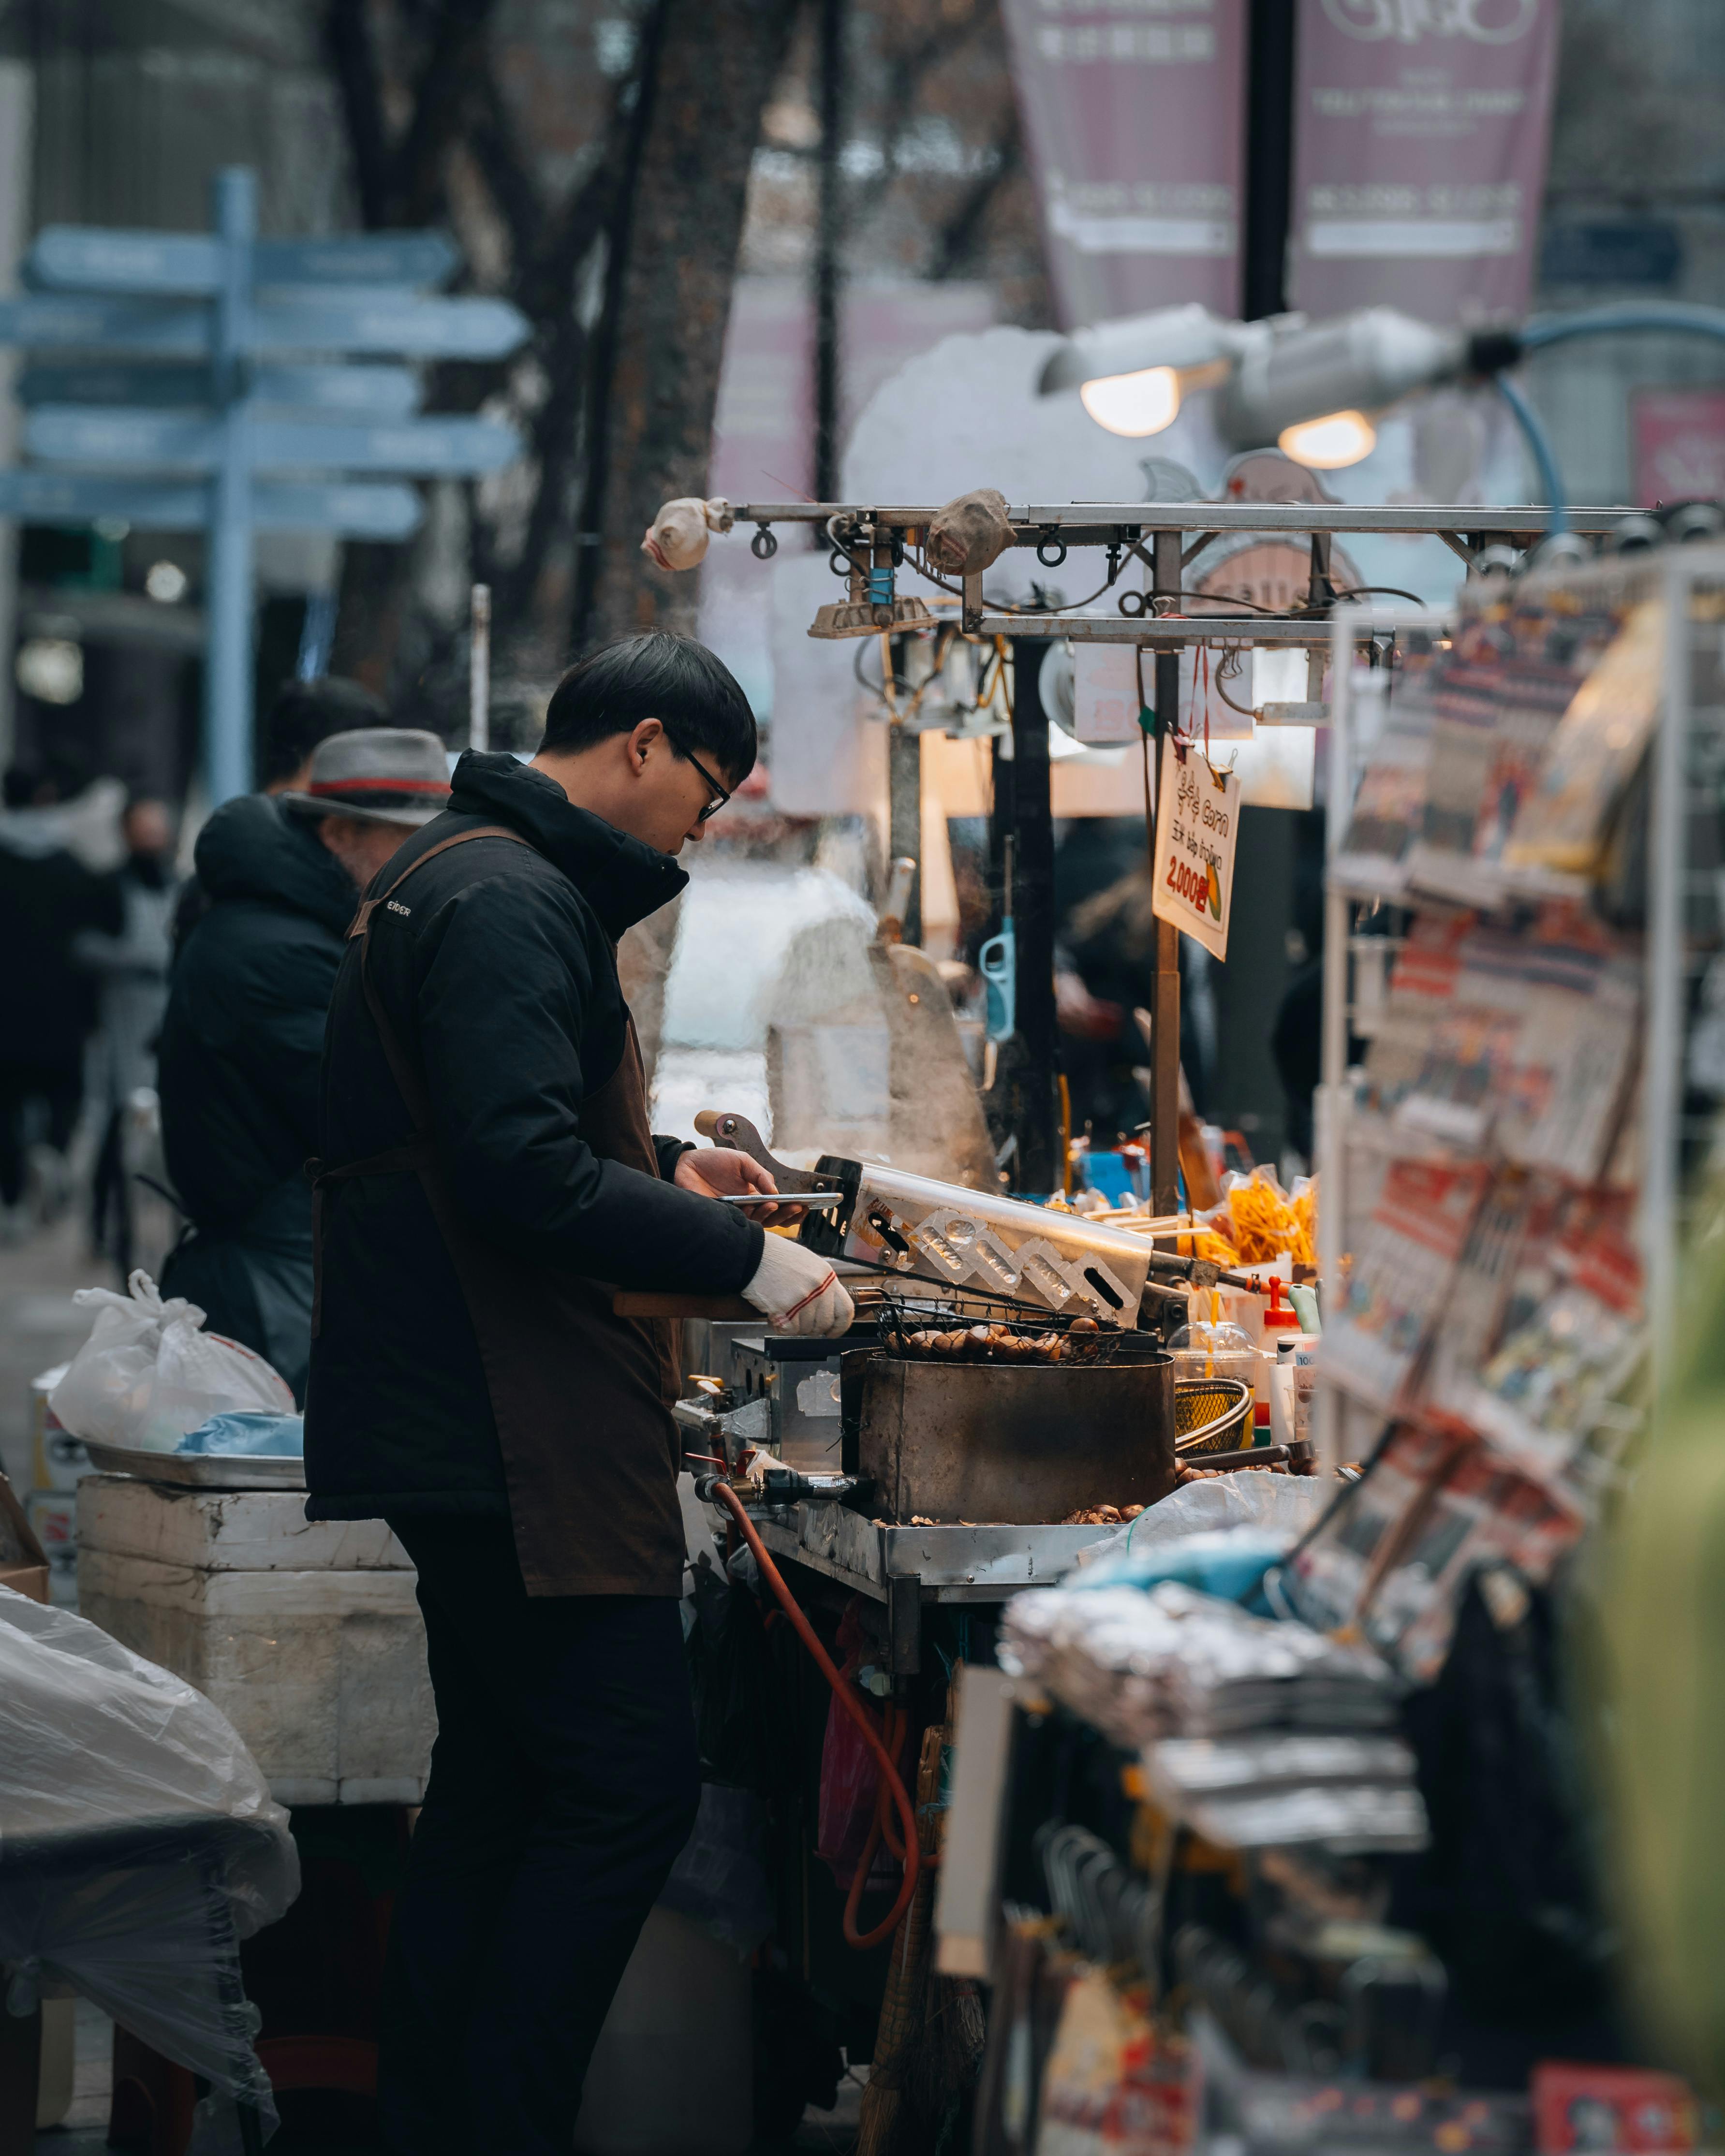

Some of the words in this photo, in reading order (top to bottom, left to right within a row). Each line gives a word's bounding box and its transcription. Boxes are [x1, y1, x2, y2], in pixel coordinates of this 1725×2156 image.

[1178, 770, 1200, 823] 옥수수
[1202, 799, 1229, 837] Corn
[1166, 855, 1209, 913] 2,000원
